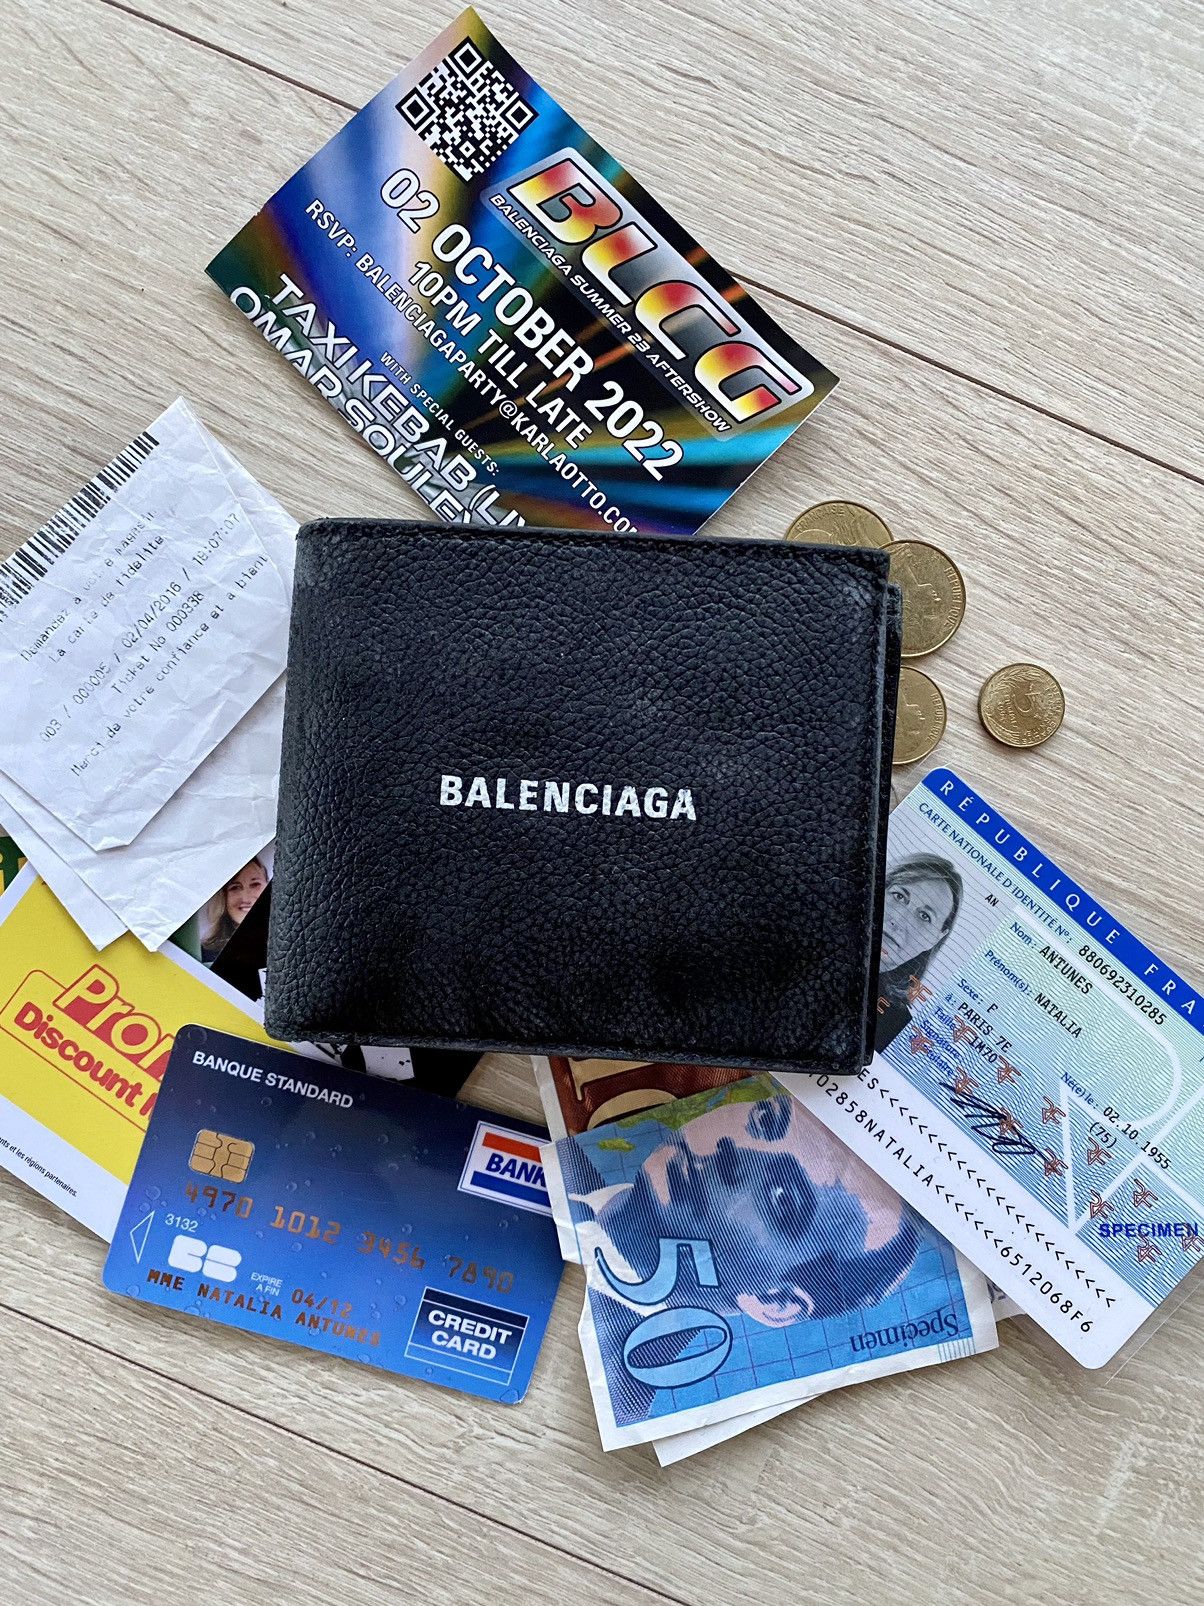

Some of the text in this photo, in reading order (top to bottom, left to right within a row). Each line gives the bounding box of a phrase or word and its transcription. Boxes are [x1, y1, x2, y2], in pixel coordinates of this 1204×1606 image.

[305, 198, 357, 258] RSVP:
[380, 168, 684, 482] 02 OCTOBER 2022
[489, 193, 732, 432] BALENCIAGA SUMMER 23 AFTERSHOW
[272, 273, 358, 369] TAXI
[347, 359, 477, 492] KEBAB
[408, 261, 593, 450] 10PM TILL LATE
[230, 286, 471, 523] OMAR SOULE
[380, 351, 500, 477] WITH SPECIAL GUESTS:
[49, 648, 66, 663] La
[101, 591, 115, 608] de
[72, 661, 111, 704] 000005
[121, 581, 182, 649] 02/04/2016
[111, 590, 205, 693] Ticket No 000338
[106, 722, 121, 738] de
[156, 622, 209, 682] confiance
[210, 604, 224, 620] et
[226, 591, 236, 601] a
[440, 774, 697, 821] BALENCIAGA
[918, 802, 950, 834] CARTE
[949, 829, 1005, 883] NATIONALE
[1078, 944, 1167, 1026] 880692310285
[940, 780, 1204, 1028] RÉPUBLIQUE FRA
[984, 893, 1000, 908] AN
[1039, 945, 1094, 995] ANTUNES
[957, 1001, 994, 1037] PARIS
[994, 1035, 1013, 1053] 7E
[986, 1002, 999, 1014] F
[1034, 992, 1083, 1039] NATALIA
[14, 1001, 143, 1108] Discount
[968, 1034, 998, 1064] 1M70
[192, 1051, 354, 1109] BANQUE STANDARD
[9, 1145, 17, 1153] et
[15, 1149, 25, 1159] les
[24, 1156, 46, 1174] régions
[1088, 1120, 1118, 1150] (75)
[1102, 1106, 1171, 1170] 02.10.1955
[165, 1213, 199, 1233] 3132
[185, 1180, 254, 1220] 4970
[270, 1206, 341, 1245] 1012
[356, 1231, 426, 1269] 3456
[808, 1072, 1093, 1333] 02858NATALIA<<<<<<<6512068F6
[1099, 1222, 1199, 1239] SPECIMEN
[147, 1269, 185, 1291] MME
[197, 1283, 282, 1320] NATALIA
[250, 1272, 283, 1287] EXPIRE
[255, 1283, 281, 1297] A FIN
[291, 1288, 353, 1319] 04/12
[428, 1309, 513, 1345] CREDIT
[594, 1237, 733, 1388] 50
[850, 1309, 960, 1353] Specimen
[431, 1330, 497, 1361] CARD
